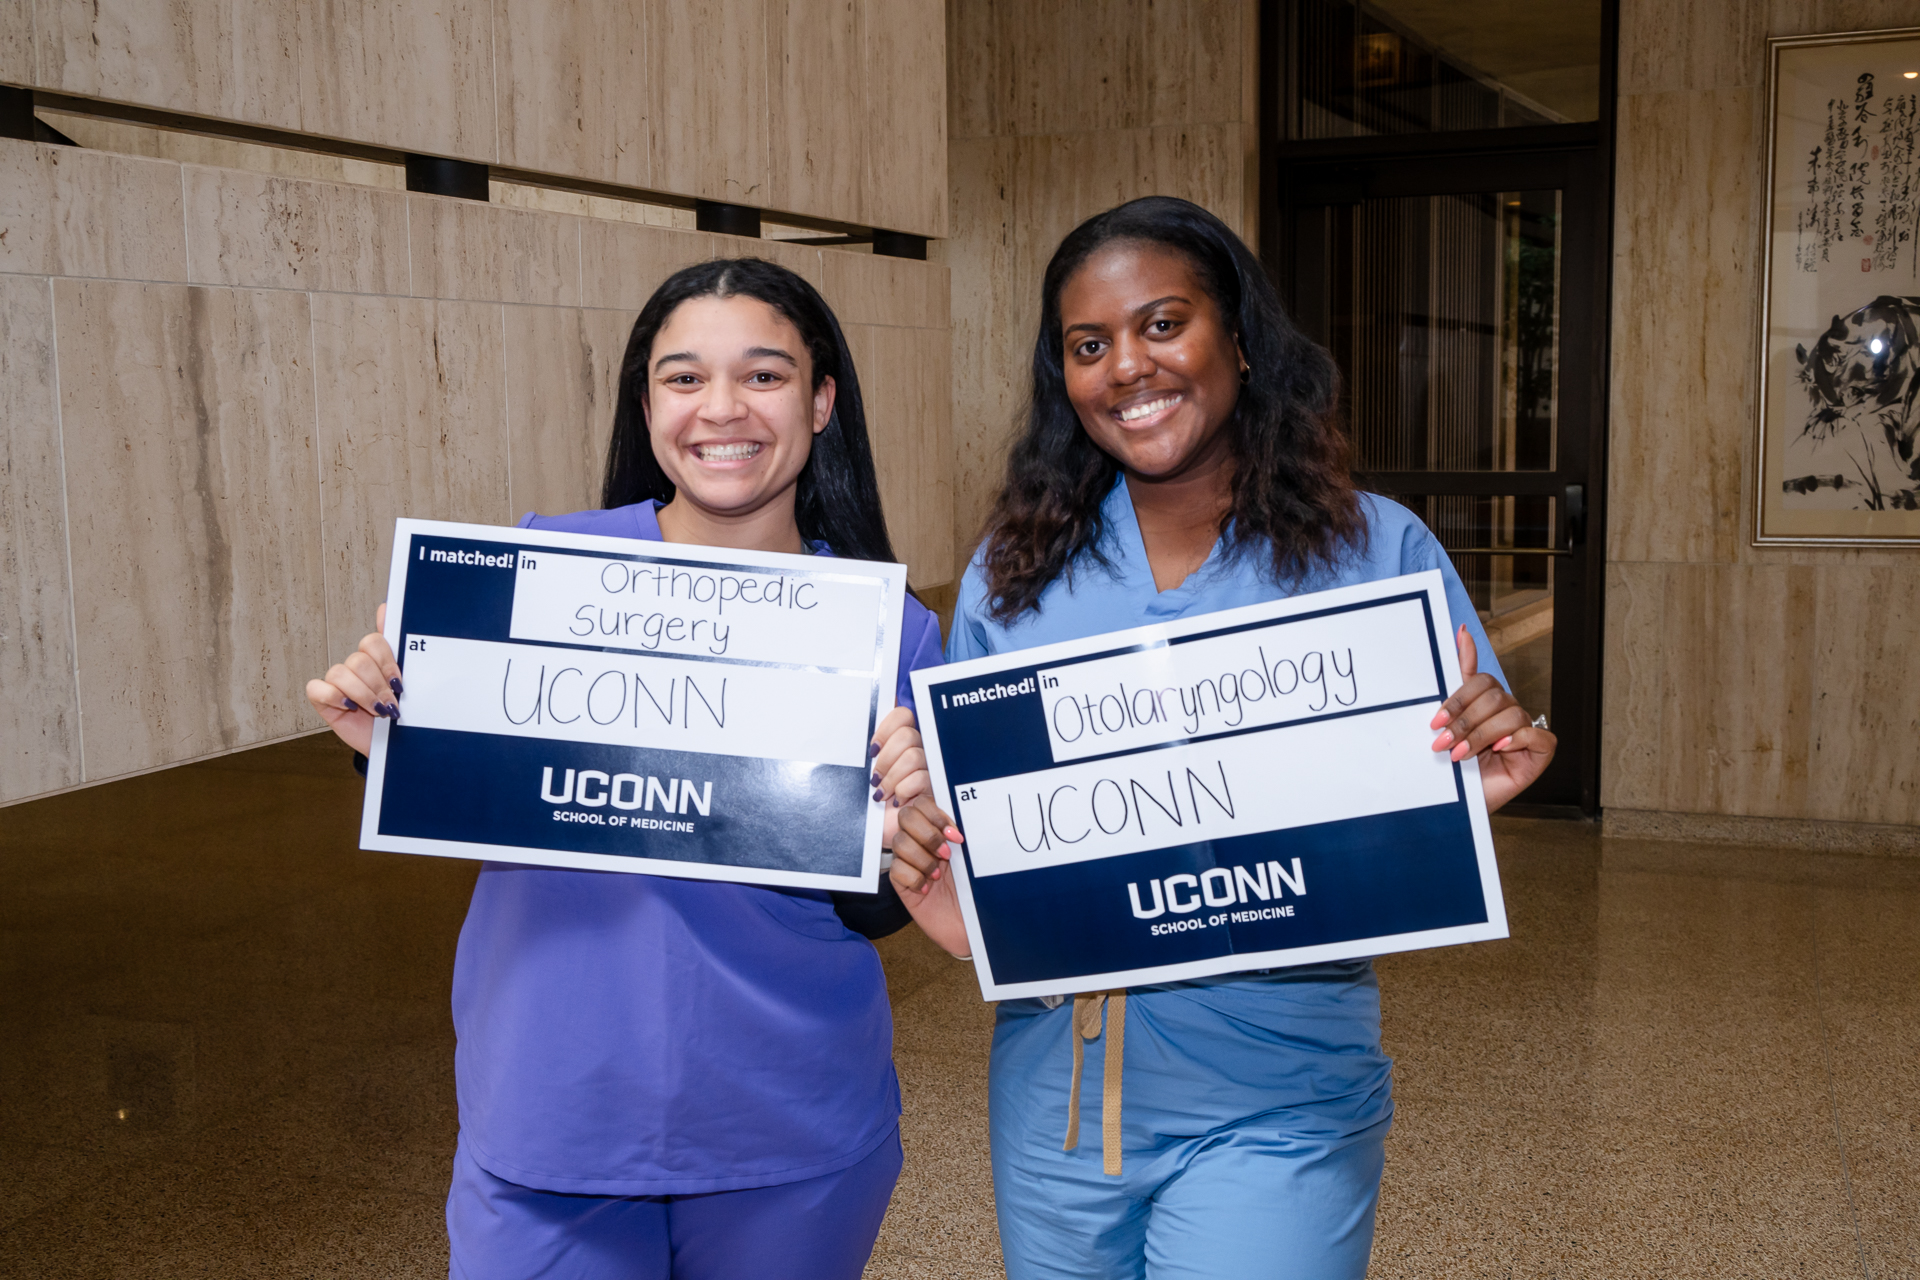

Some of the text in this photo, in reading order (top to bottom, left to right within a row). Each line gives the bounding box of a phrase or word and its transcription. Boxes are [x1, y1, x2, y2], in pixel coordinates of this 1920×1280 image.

[419, 545, 537, 571] I matched! in
[600, 562, 819, 616] Orthopedic
[408, 638, 427, 652] at
[502, 658, 727, 729] UCONN
[941, 674, 1060, 709] I matched! in
[1053, 646, 1358, 743] Otolaryngology
[540, 766, 713, 817] UCONN
[960, 786, 978, 802] at
[1007, 760, 1235, 853] UCONN
[552, 810, 695, 833] SCHOOL OF MEDICINE
[1127, 858, 1307, 920] UCONN
[1150, 904, 1295, 936] SCHOOL OF MEDICINE
